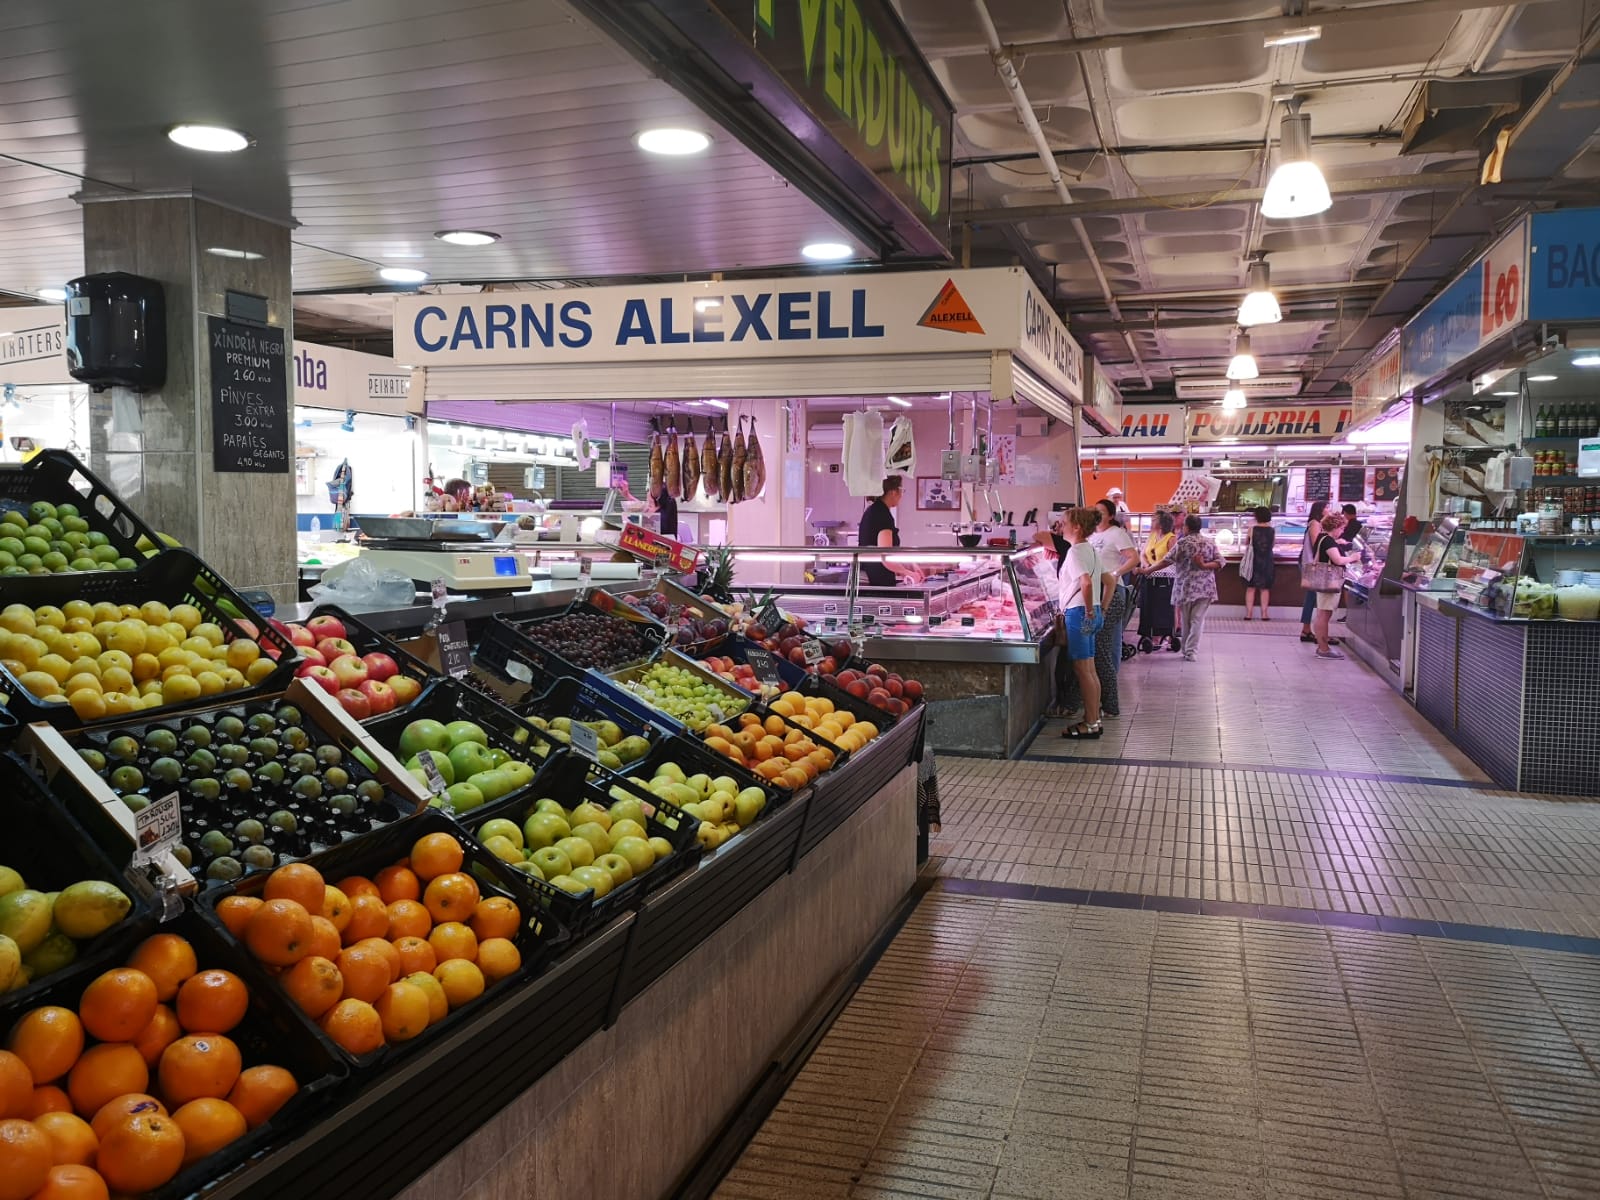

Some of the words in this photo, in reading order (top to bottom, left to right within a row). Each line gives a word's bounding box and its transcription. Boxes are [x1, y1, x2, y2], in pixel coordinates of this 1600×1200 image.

[800, 0, 941, 216] VERDURES
[1482, 259, 1519, 337] Leo
[414, 300, 593, 352] CARNS
[615, 289, 884, 346] ALEXELL
[930, 312, 973, 323] ALEXELL
[1025, 289, 1051, 361] CARNS
[226, 352, 270, 370] PREMIUM
[368, 378, 410, 395] PEIXATE
[246, 405, 276, 417] EXTRA
[1191, 409, 1321, 437] POLLERIA
[253, 448, 285, 460] GEGANTS
